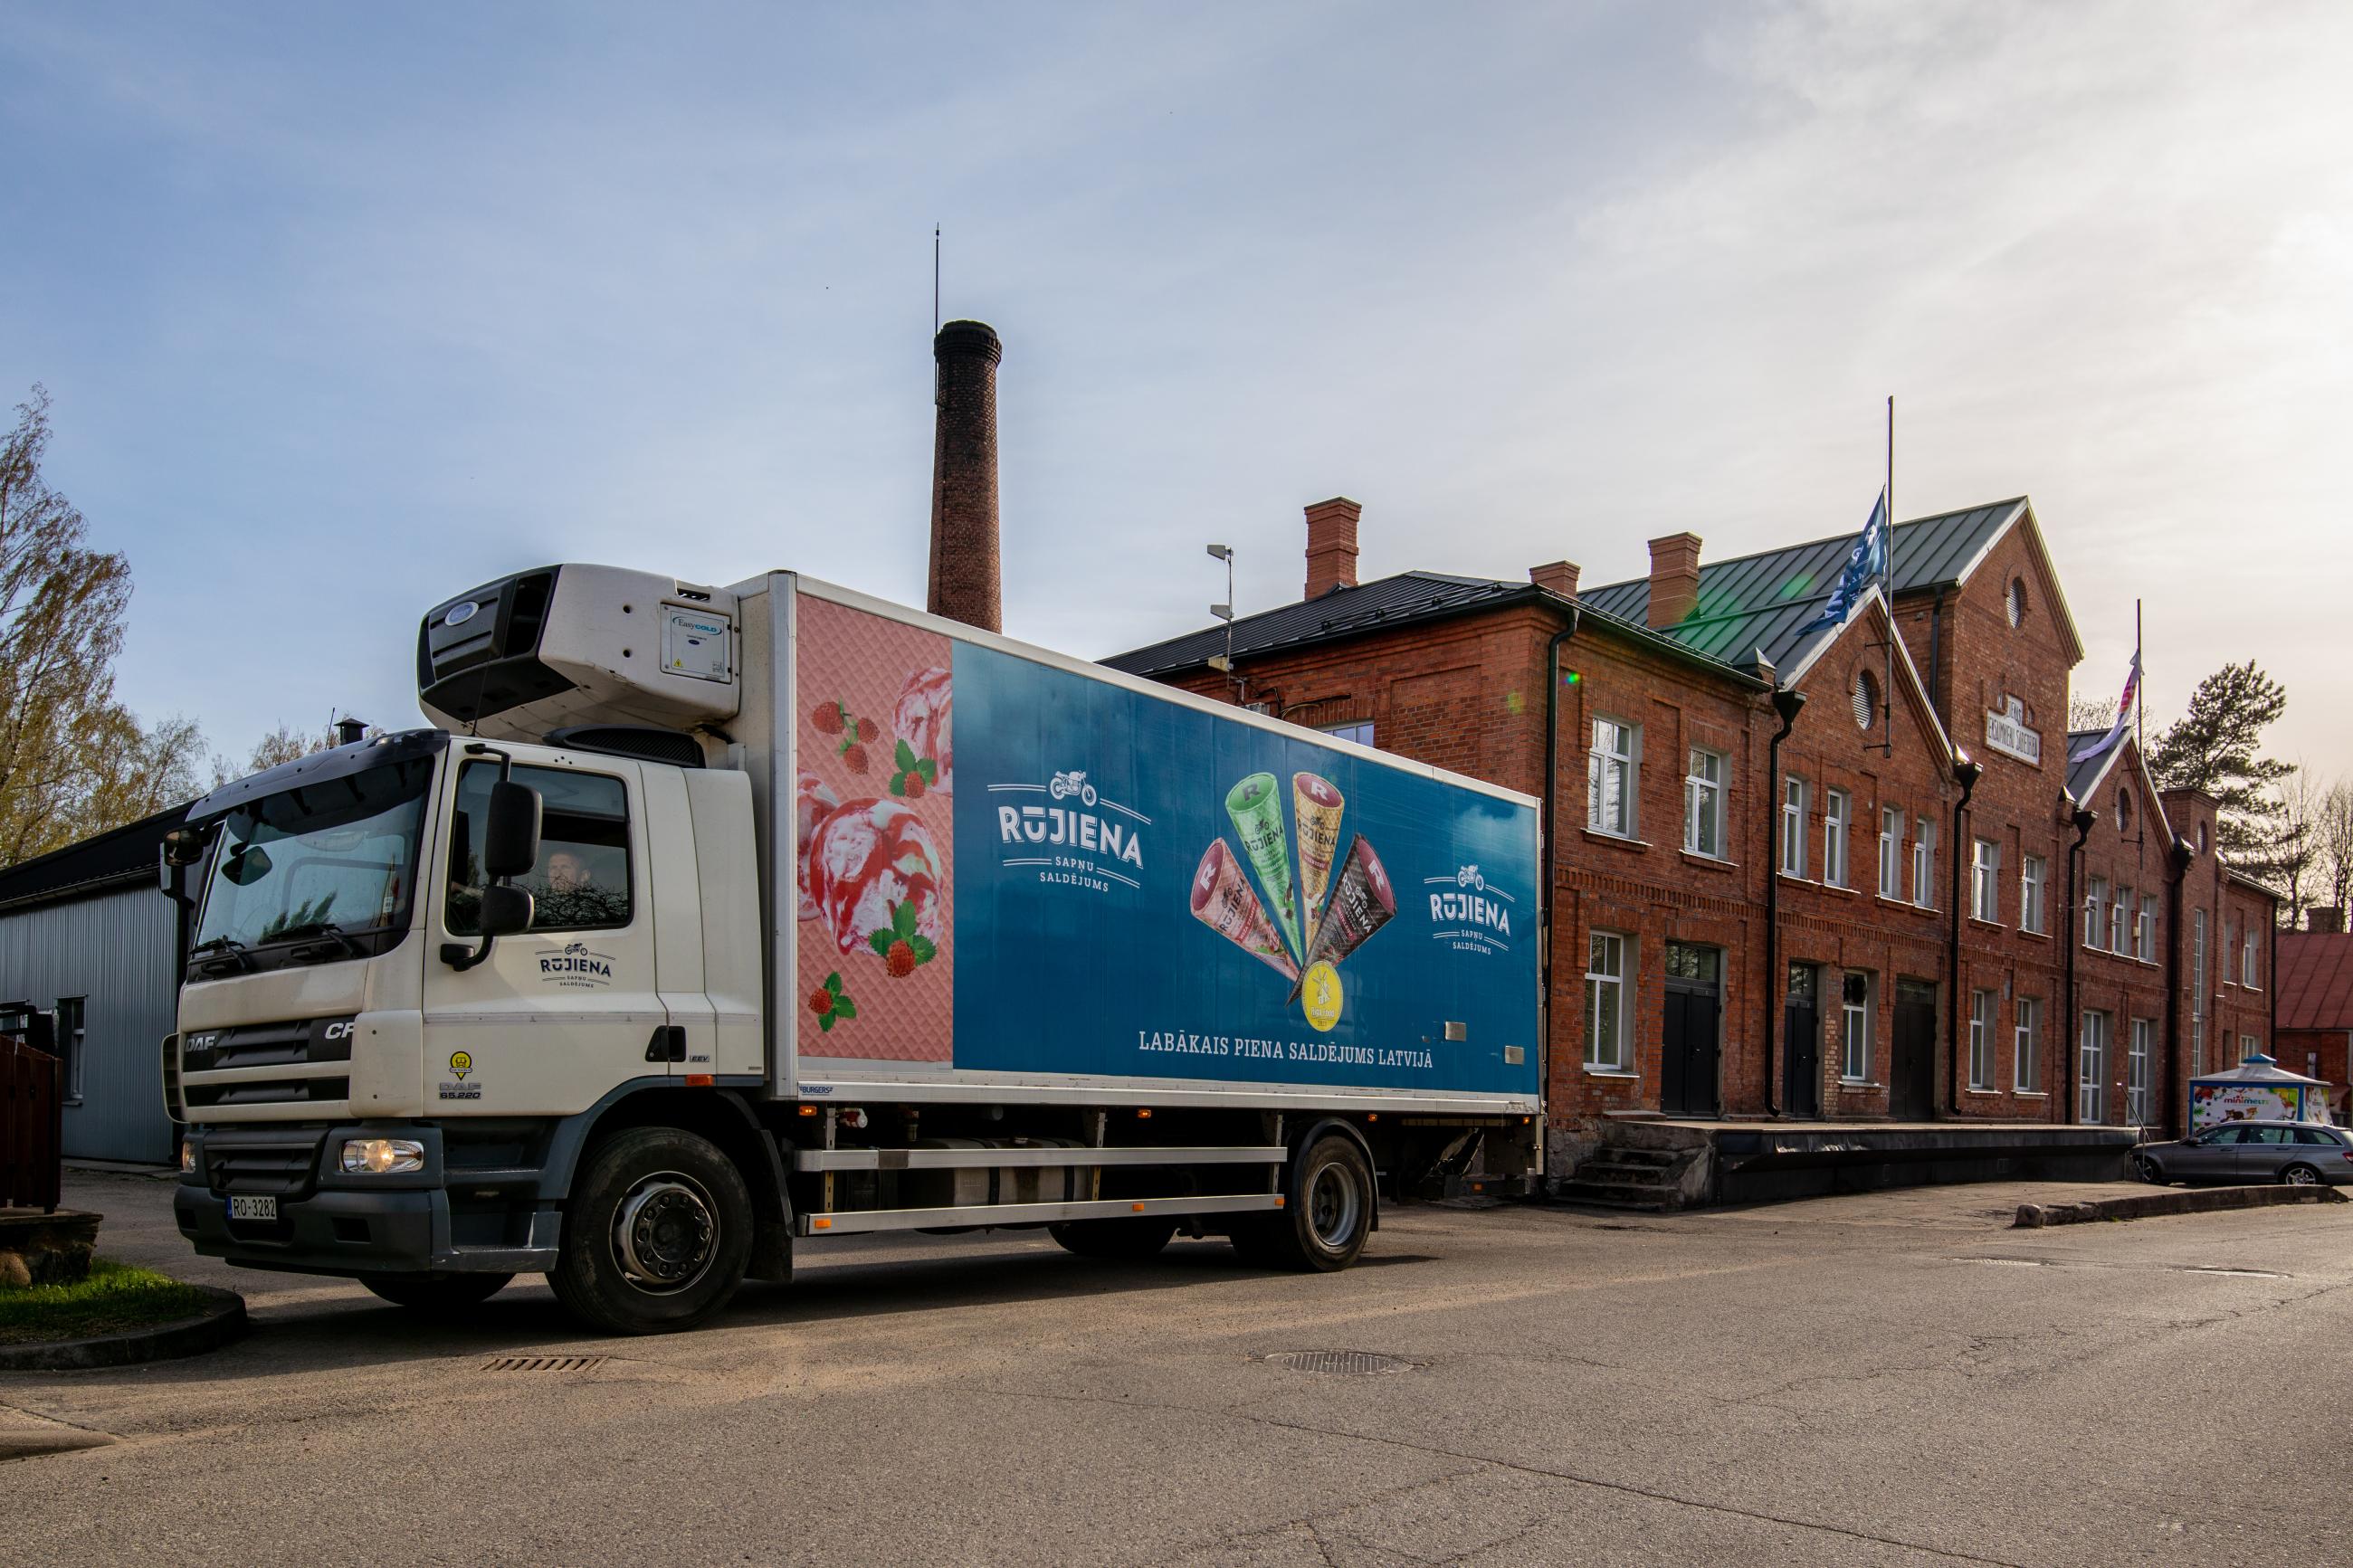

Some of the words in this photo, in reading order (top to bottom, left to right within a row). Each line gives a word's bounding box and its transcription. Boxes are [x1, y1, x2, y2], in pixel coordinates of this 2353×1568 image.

[998, 805, 1144, 870] RŪJIENA
[1244, 822, 1284, 855] RŪJIENA
[1055, 856, 1094, 873] SAPŅU
[1040, 871, 1109, 892] SALDĒJUMS
[1218, 877, 1246, 932] RŪJIENA
[1341, 871, 1372, 934] RŪJIENA
[1430, 893, 1510, 936] RŪJIENA
[1461, 929, 1483, 941] SAPŅU
[1453, 942, 1491, 955] SALDĒJUMS
[539, 957, 612, 977] RŪJIENA
[186, 1036, 215, 1052] DAF
[1138, 1030, 1229, 1055] LABĀKAIS
[1234, 1038, 1284, 1059] PIENA
[1289, 1041, 1375, 1064] SALDĒJUMS
[1378, 1049, 1433, 1069] LATVIJĀ
[440, 1082, 481, 1091] DAF
[802, 1086, 830, 1094] BURGERS
[233, 1199, 275, 1217] RO-3282
